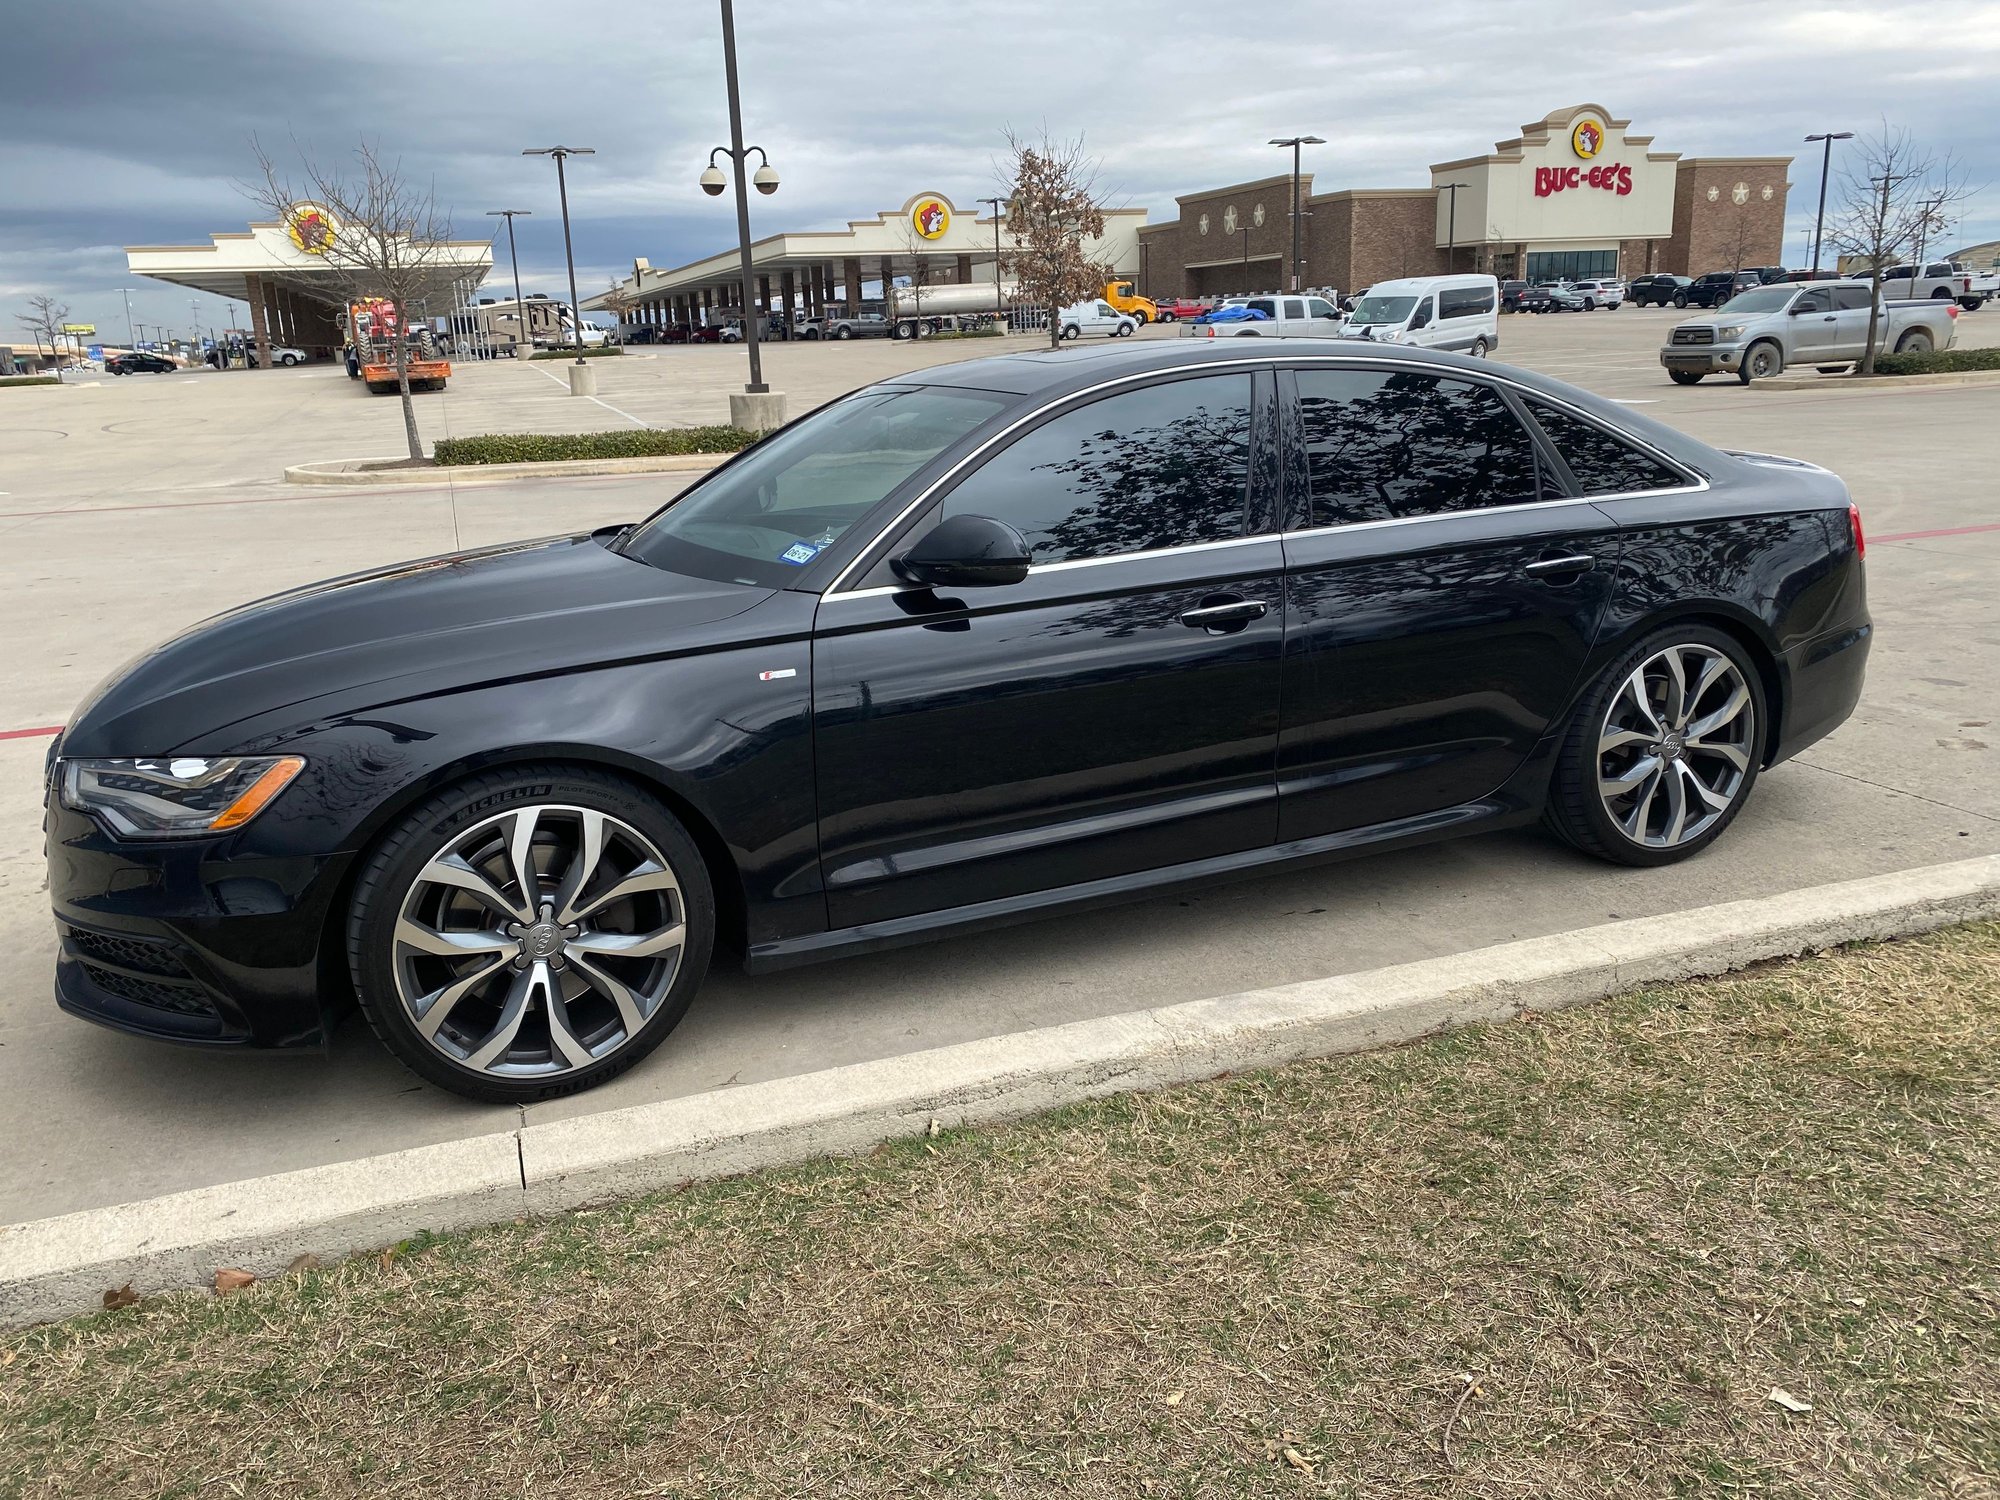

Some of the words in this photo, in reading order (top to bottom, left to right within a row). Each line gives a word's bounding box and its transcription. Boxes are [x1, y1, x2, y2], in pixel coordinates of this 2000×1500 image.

[1535, 163, 1632, 197] BUC-EE'S
[456, 785, 547, 820] MICHELIN
[558, 785, 585, 793] PILOT
